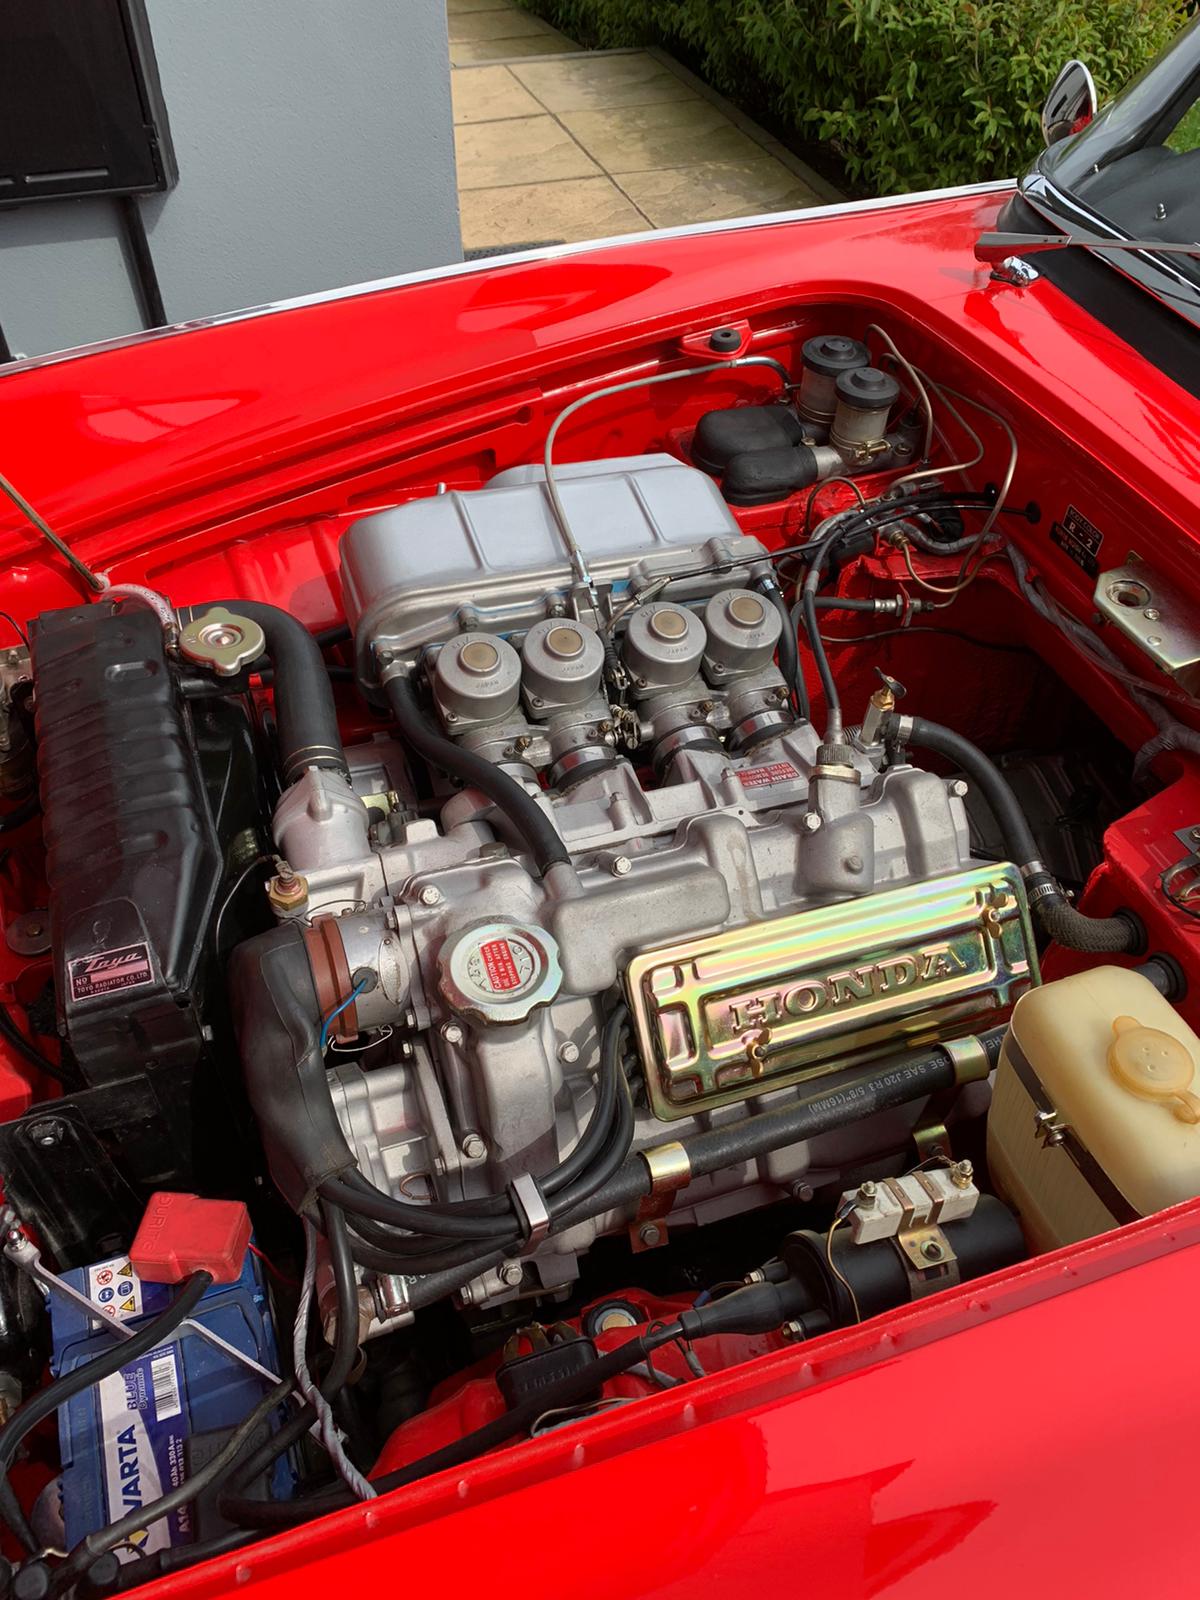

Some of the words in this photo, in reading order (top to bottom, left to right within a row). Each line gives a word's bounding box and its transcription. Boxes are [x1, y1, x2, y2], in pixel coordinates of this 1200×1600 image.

[771, 771, 798, 781] DRAIN
[487, 961, 501, 989] CAUTION
[95, 977, 125, 988] RADIATOR
[729, 944, 967, 1031] HONDA
[885, 1072, 902, 1084] J20
[905, 1066, 927, 1079] SAE
[868, 1078, 884, 1092] R3
[123, 1372, 138, 1411] BLUE
[117, 1423, 143, 1515] VARTA
